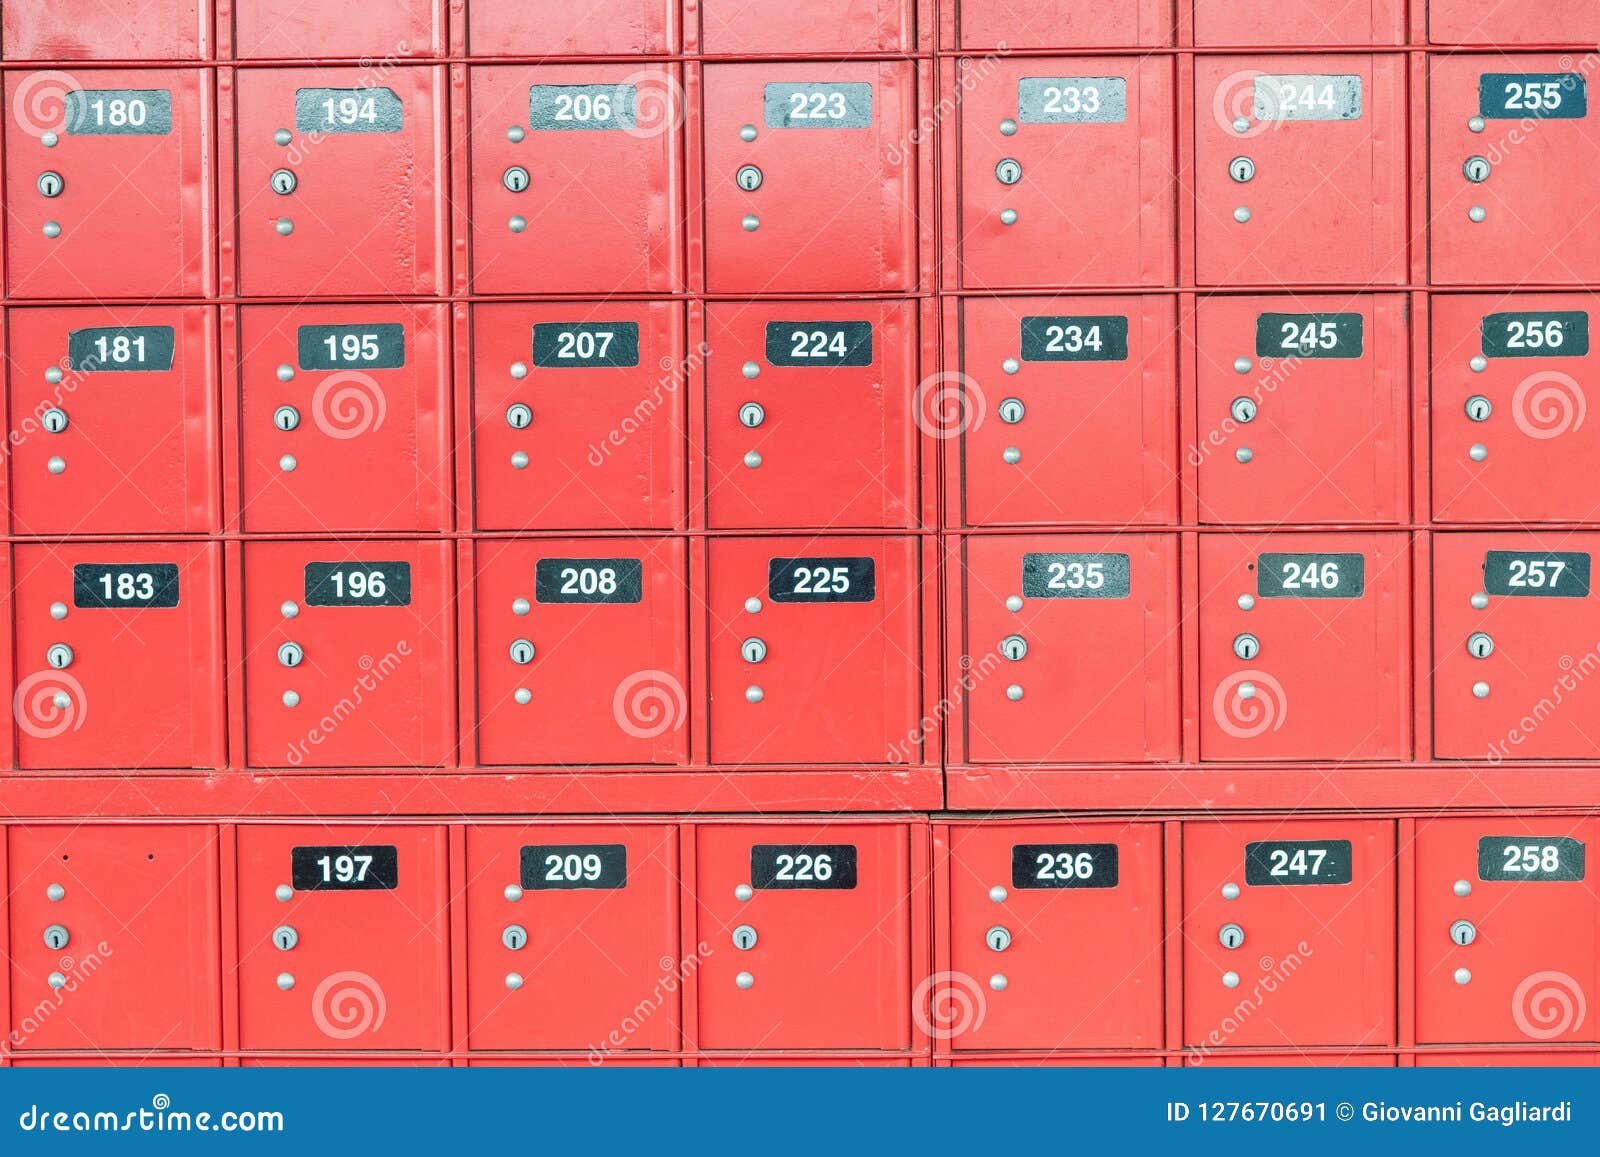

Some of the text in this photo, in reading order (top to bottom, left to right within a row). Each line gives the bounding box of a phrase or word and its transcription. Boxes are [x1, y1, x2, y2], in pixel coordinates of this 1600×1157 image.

[554, 93, 612, 122] 206
[789, 91, 847, 120] 223
[1043, 86, 1101, 114] 233
[1278, 83, 1337, 111] 244
[1504, 82, 1562, 110] 255
[91, 98, 147, 127] 180
[322, 97, 379, 125] 194
[323, 334, 380, 361] 195
[557, 331, 614, 359] 207
[790, 330, 848, 357] 224
[1045, 325, 1103, 353] 234
[1279, 321, 1338, 350] 245
[1506, 320, 1564, 348] 256
[94, 335, 145, 363] 181
[99, 572, 154, 600] 183
[330, 571, 386, 598] 196
[560, 567, 617, 595] 208
[793, 566, 850, 594] 225
[1047, 562, 1105, 590] 235
[1282, 562, 1339, 590] 246
[1508, 559, 1566, 588] 257
[317, 855, 373, 882] 197
[545, 854, 602, 881] 209
[775, 853, 832, 881] 226
[1036, 852, 1094, 880] 236
[1270, 849, 1327, 876] 247
[1502, 845, 1560, 873] 258
